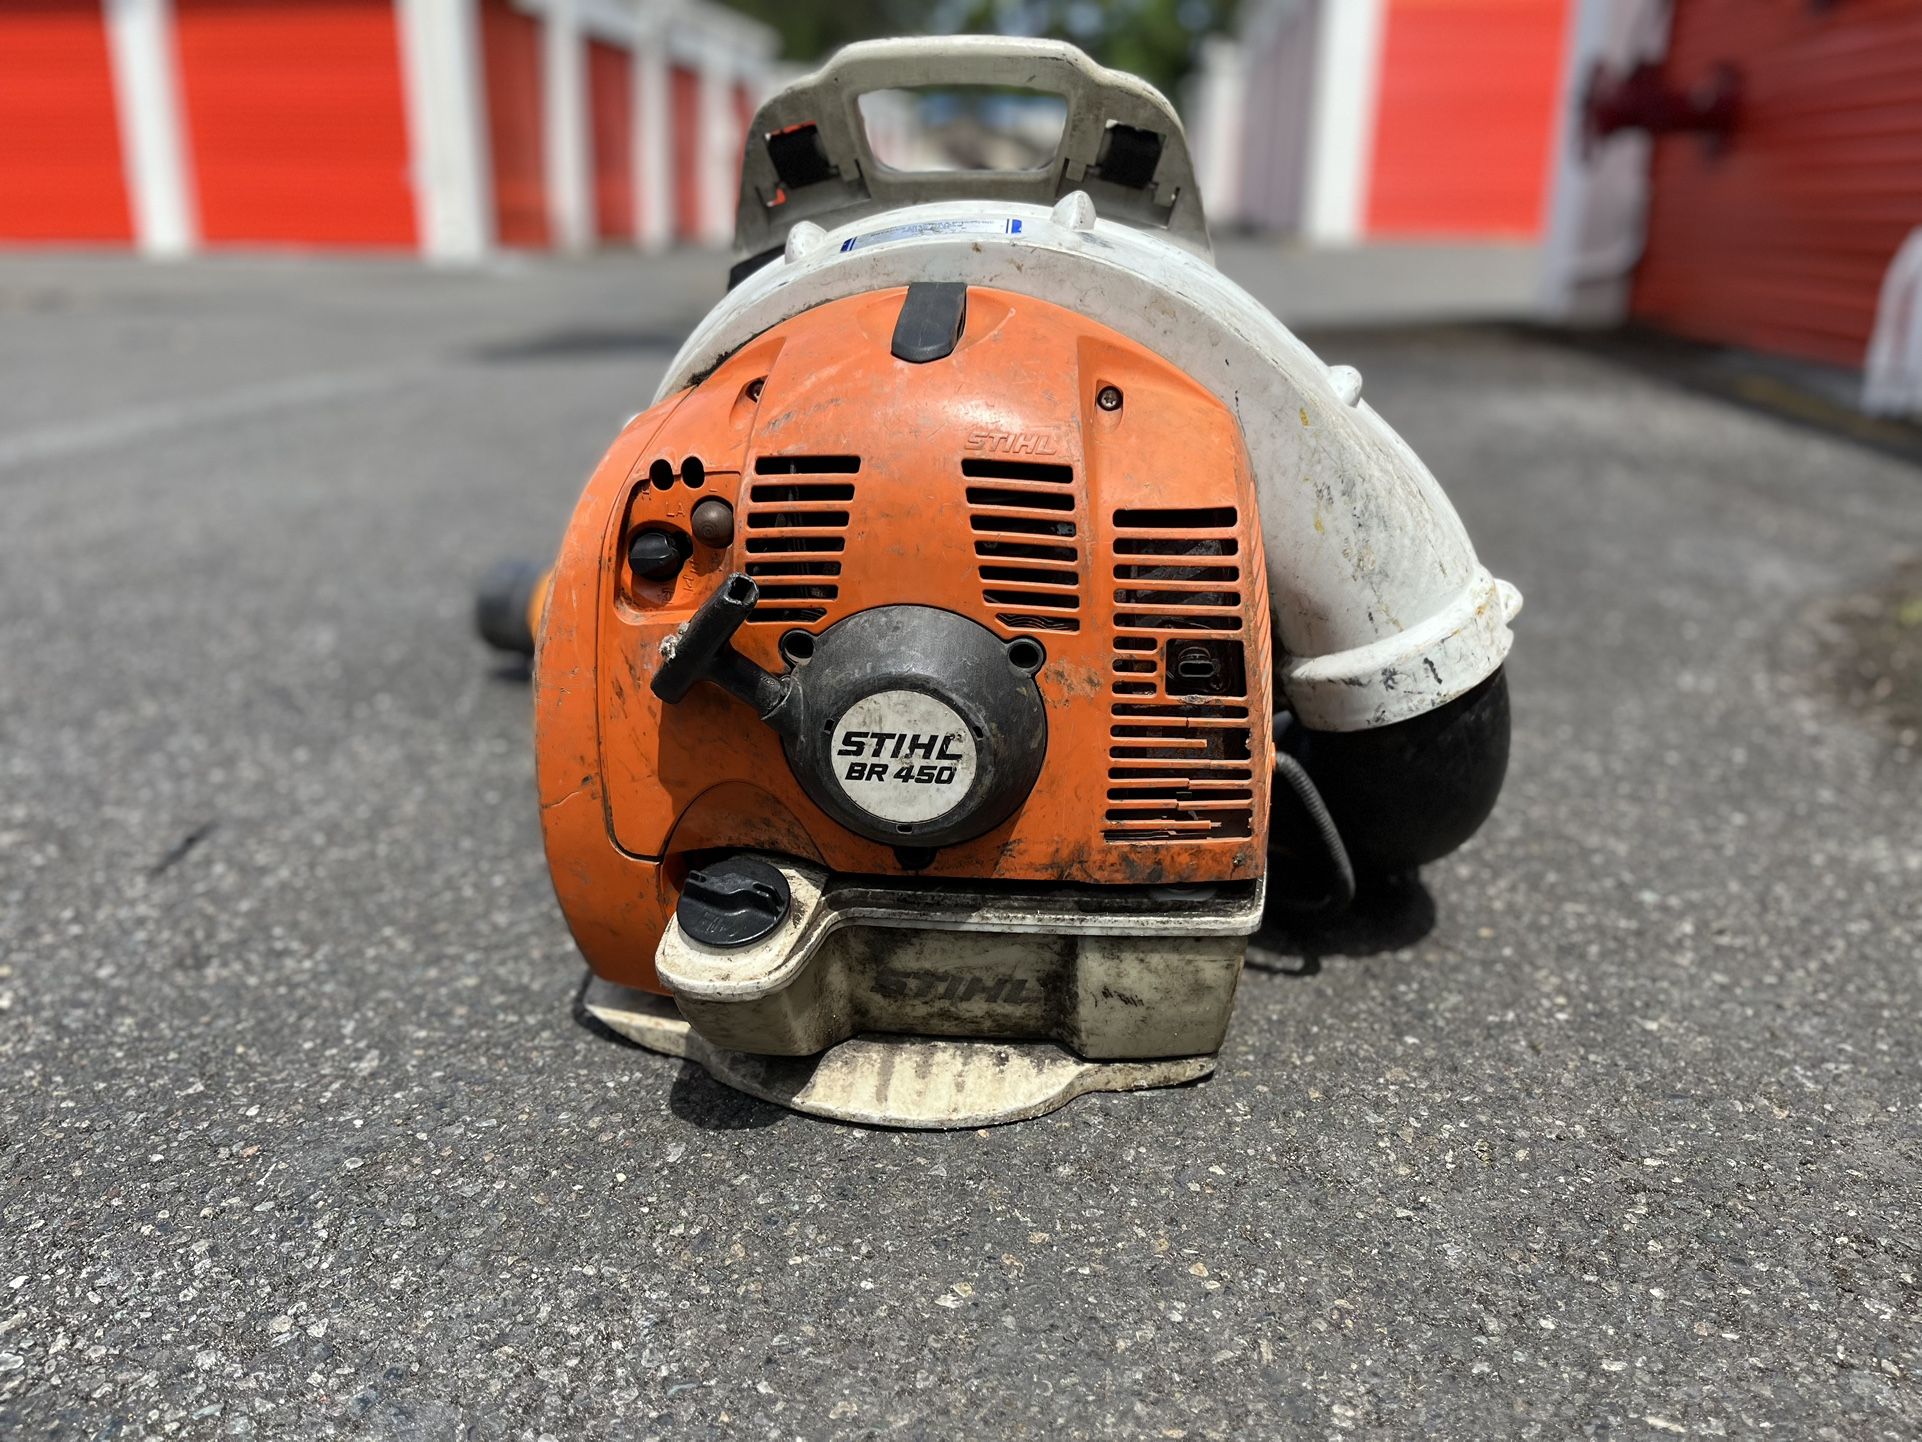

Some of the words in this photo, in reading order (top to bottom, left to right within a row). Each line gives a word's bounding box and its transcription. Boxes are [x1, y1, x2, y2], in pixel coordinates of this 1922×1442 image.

[964, 430, 1057, 456] STIHL
[837, 731, 963, 761] STIHL
[845, 763, 889, 782] BR
[893, 765, 958, 785] 450
[870, 968, 1042, 1003] STIHL
